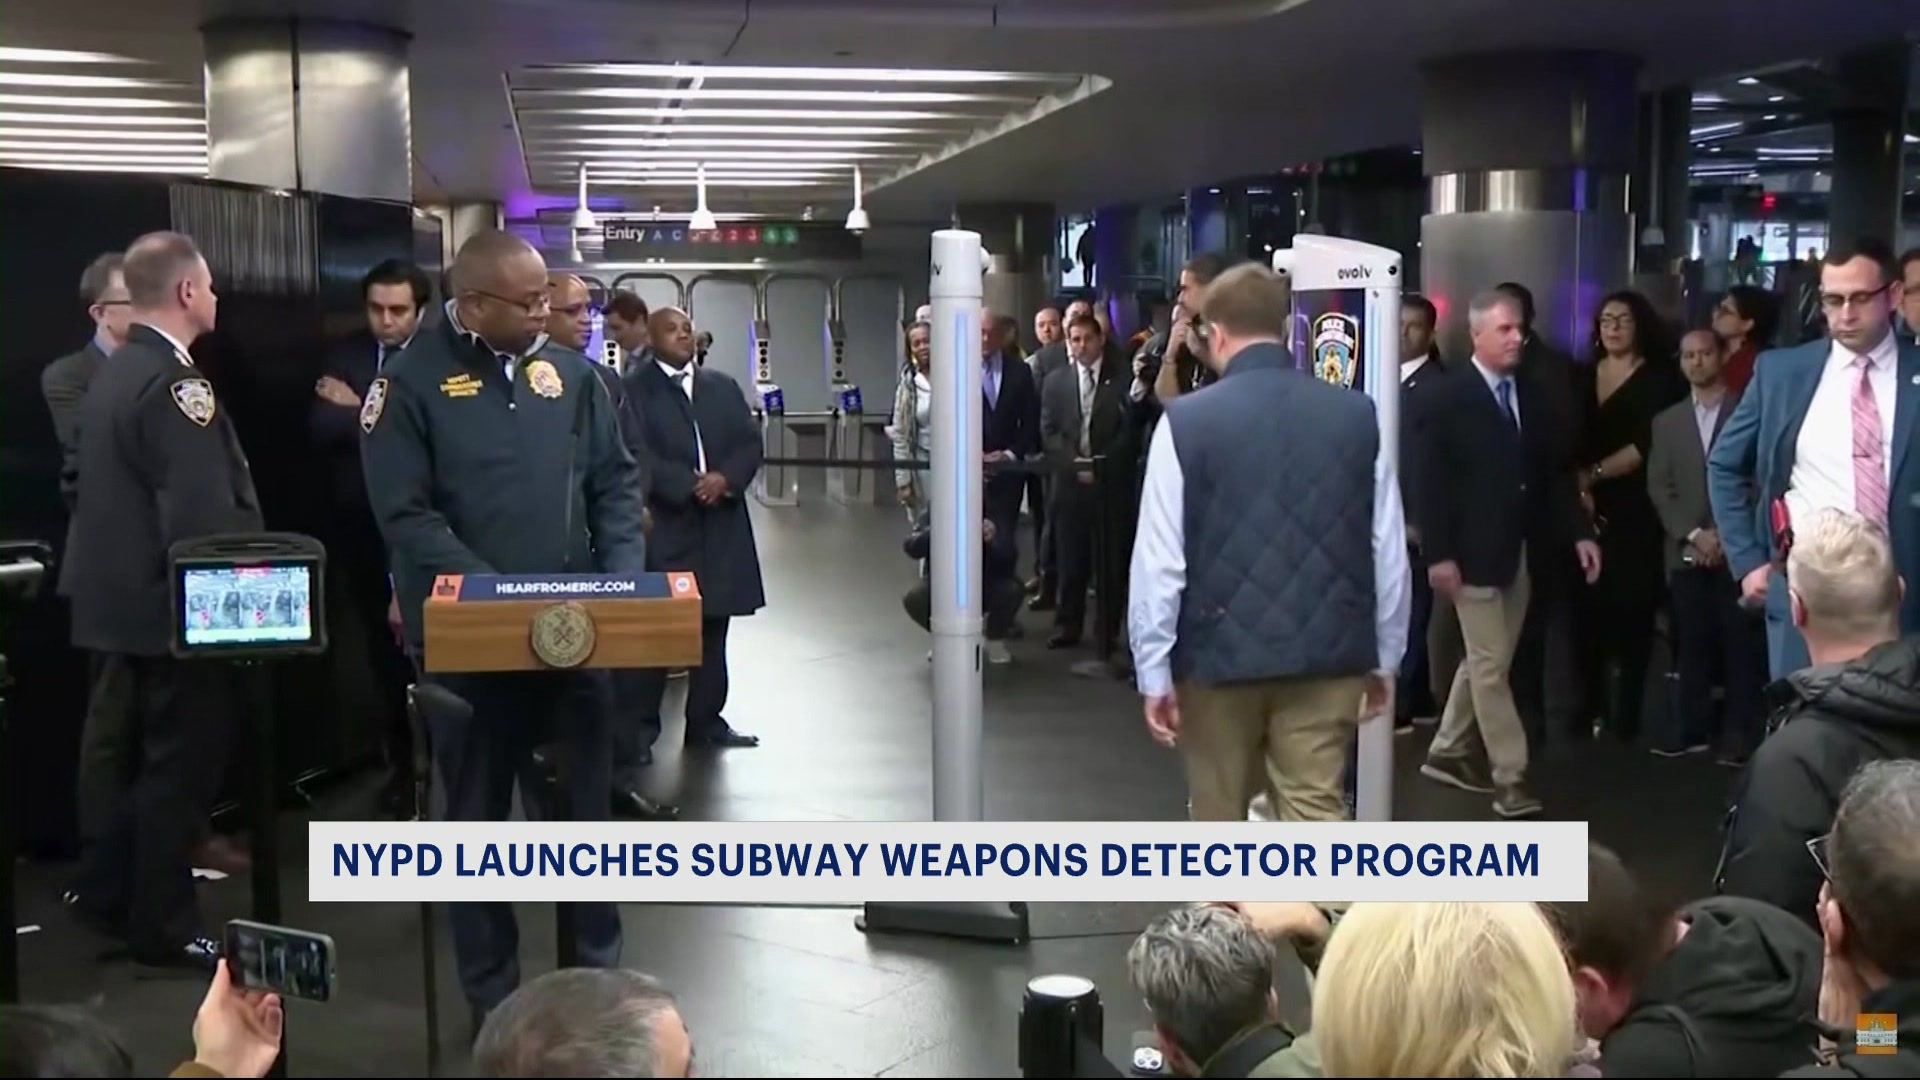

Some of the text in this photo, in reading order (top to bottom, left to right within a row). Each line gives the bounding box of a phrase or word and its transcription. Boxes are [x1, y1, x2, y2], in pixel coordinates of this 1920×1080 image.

[605, 226, 645, 243] Entry
[653, 230, 662, 240] A
[672, 230, 681, 240] C
[1338, 265, 1372, 280] evolv
[496, 581, 635, 594] HEARFROMERIC.COM
